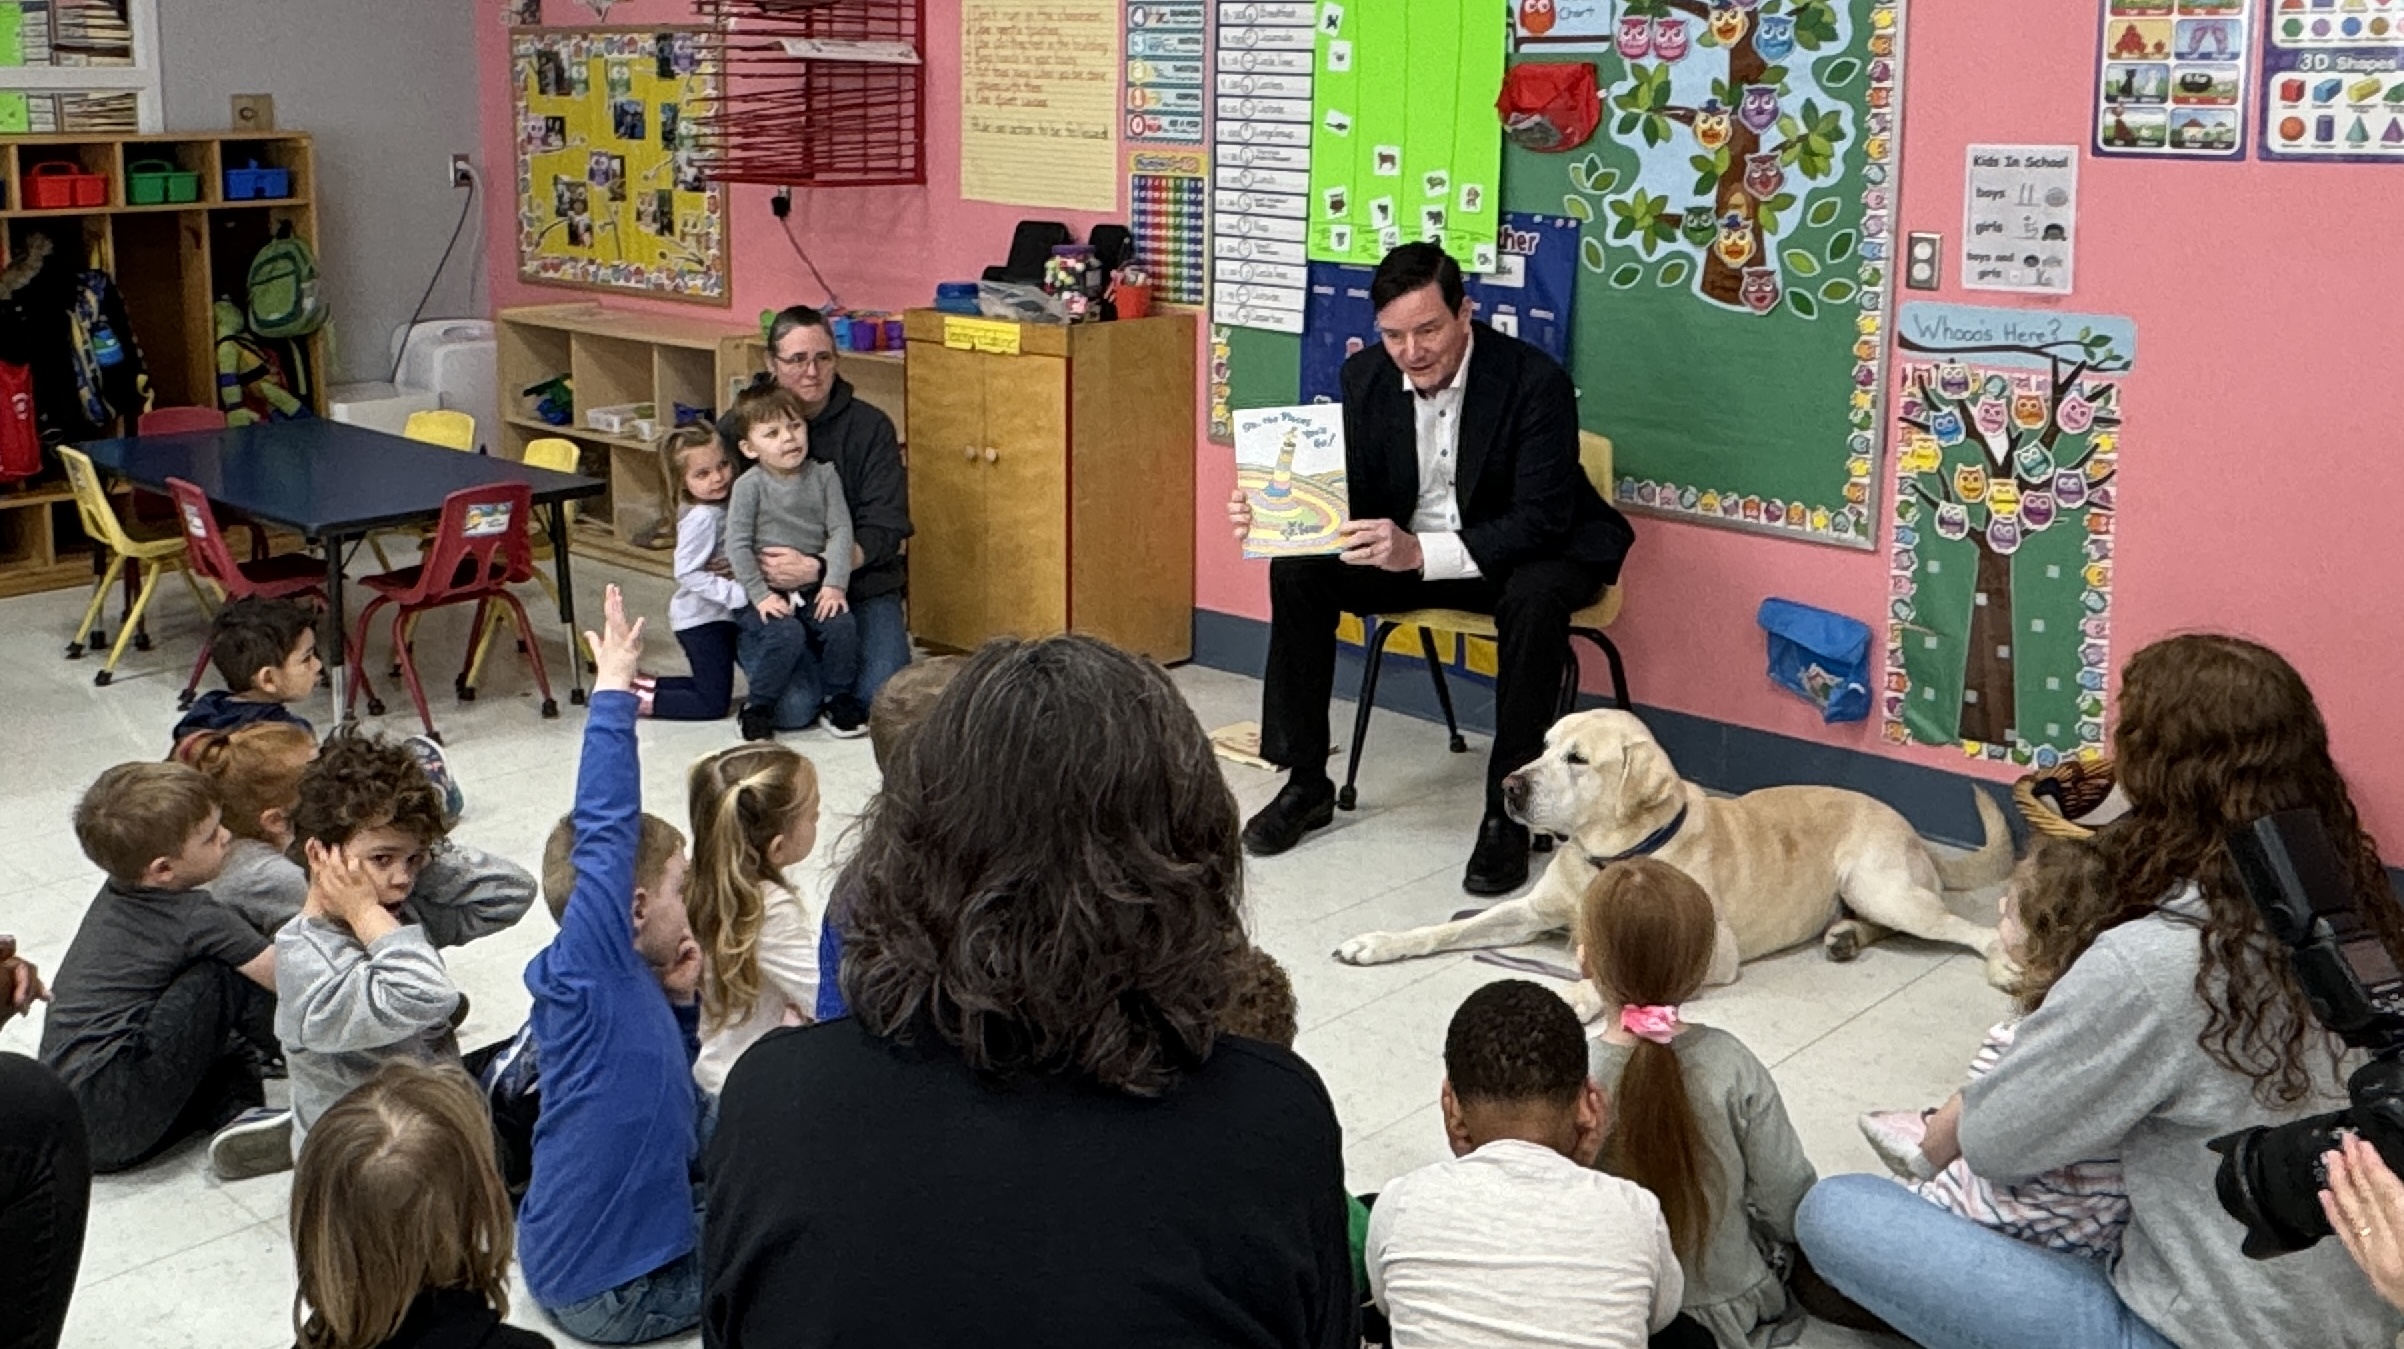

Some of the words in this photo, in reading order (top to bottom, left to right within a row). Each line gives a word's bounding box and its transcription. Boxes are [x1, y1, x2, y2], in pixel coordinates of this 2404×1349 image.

[2299, 53, 2329, 70] 3D
[2336, 57, 2397, 72] Shapes
[1973, 154, 1999, 168] Kids
[2003, 155, 2020, 168] In
[2024, 156, 2069, 168] School
[1975, 187, 2005, 201] boys
[1975, 220, 2003, 235] girls
[1966, 252, 1991, 263] boys
[1912, 313, 1994, 342] Whooo's
[2003, 317, 2063, 342] Here?
